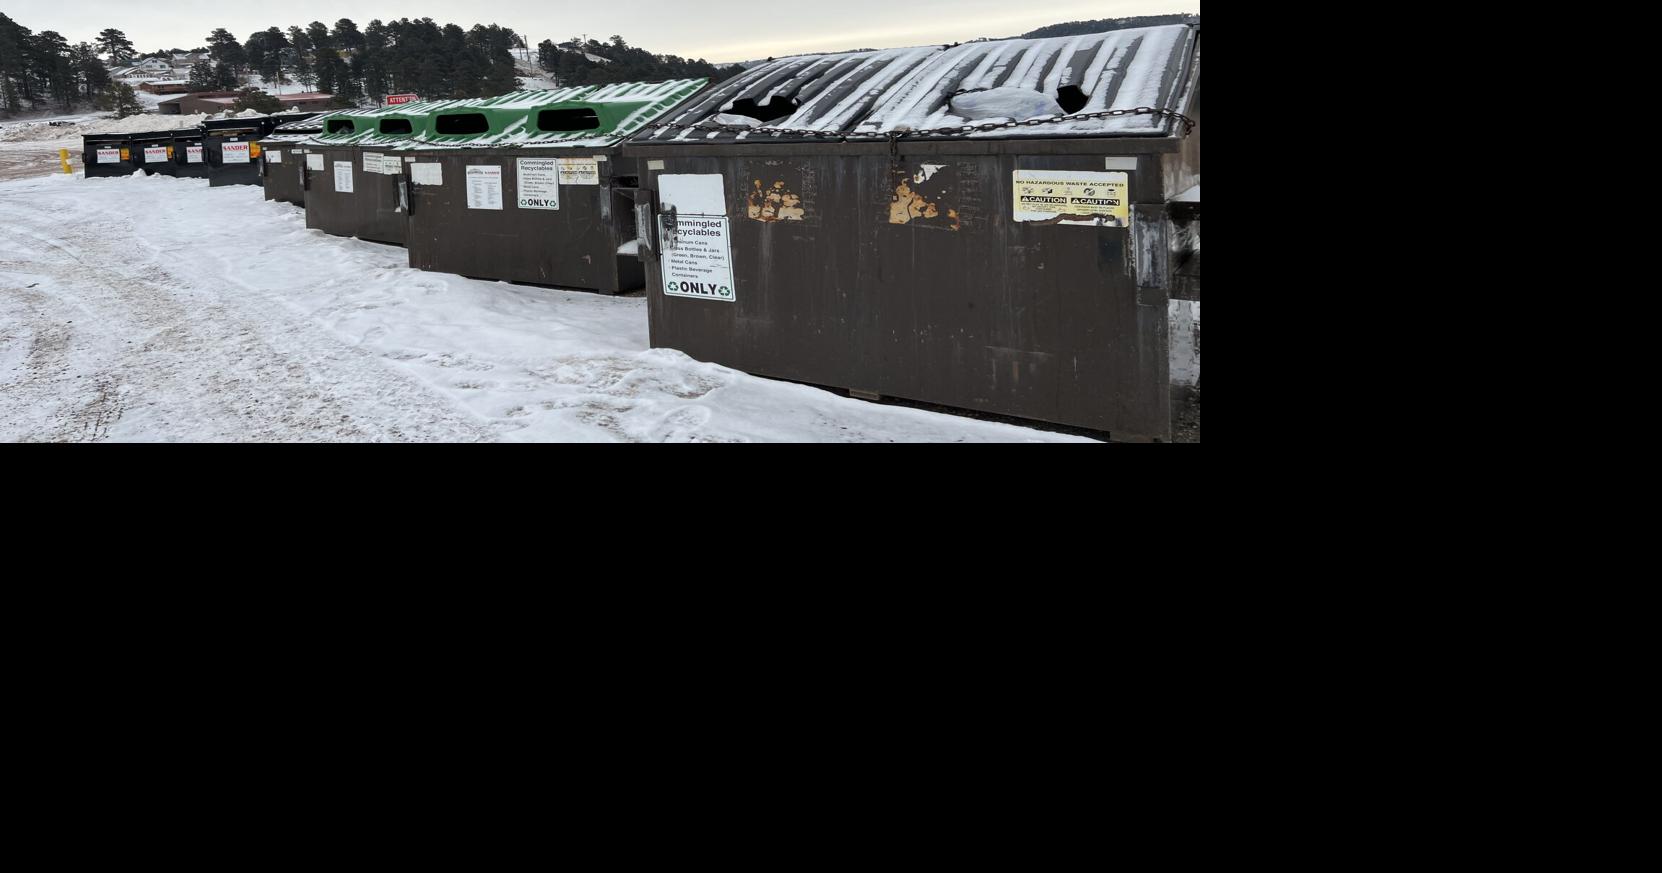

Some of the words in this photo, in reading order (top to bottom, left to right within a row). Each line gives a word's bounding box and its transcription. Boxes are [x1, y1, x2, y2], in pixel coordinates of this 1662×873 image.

[389, 96, 417, 104] ATTENT
[527, 199, 549, 207] ONLY
[671, 220, 722, 228] mmingled
[679, 281, 717, 295] ONLY
